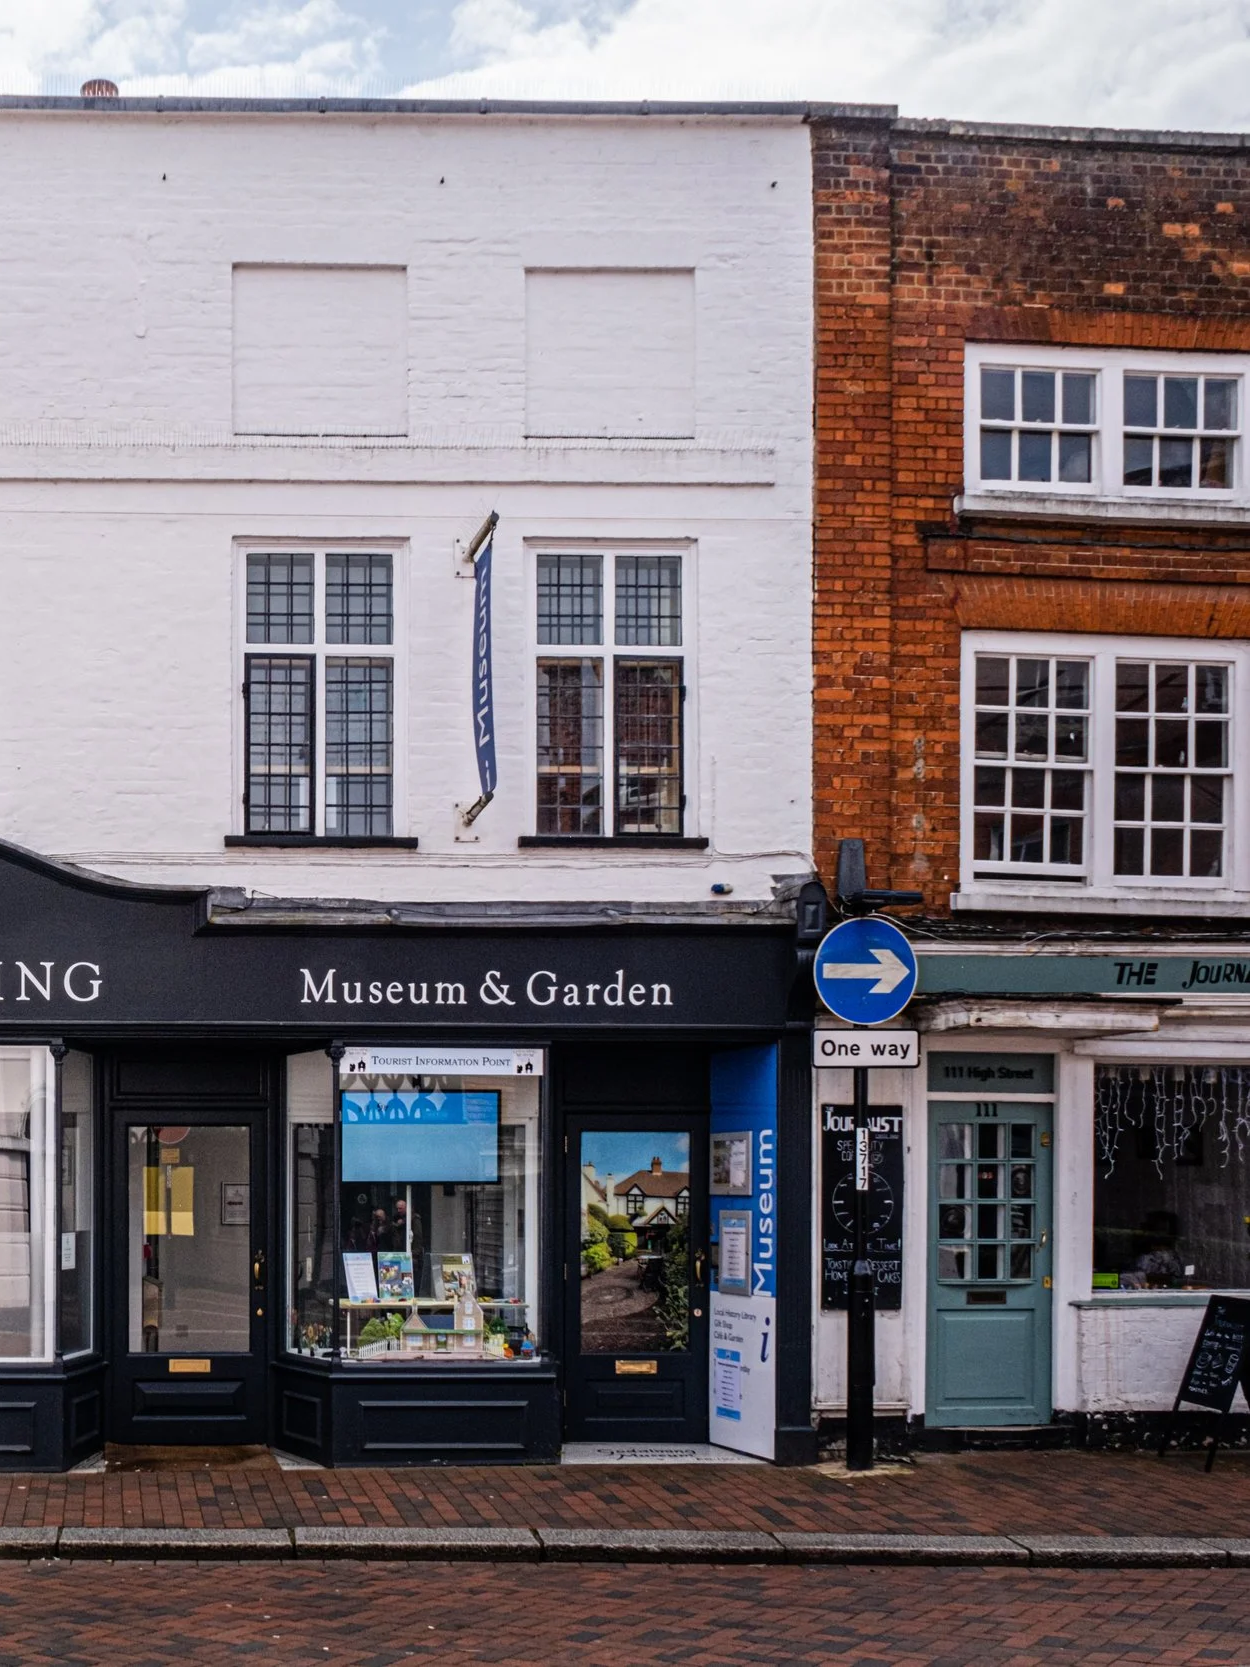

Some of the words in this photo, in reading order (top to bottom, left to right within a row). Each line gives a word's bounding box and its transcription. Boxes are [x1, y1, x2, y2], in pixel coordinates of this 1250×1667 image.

[477, 566, 491, 748] Museum
[1114, 962, 1158, 985] THE
[300, 968, 468, 1005] Museum
[479, 970, 516, 1006] &
[526, 969, 674, 1007] Garden
[821, 1039, 861, 1056] One
[870, 1043, 911, 1060] way
[944, 1066, 964, 1078] 111
[967, 1066, 995, 1082] High
[997, 1066, 1034, 1080] Street
[975, 1102, 998, 1117] 111
[753, 1129, 773, 1296] Museum
